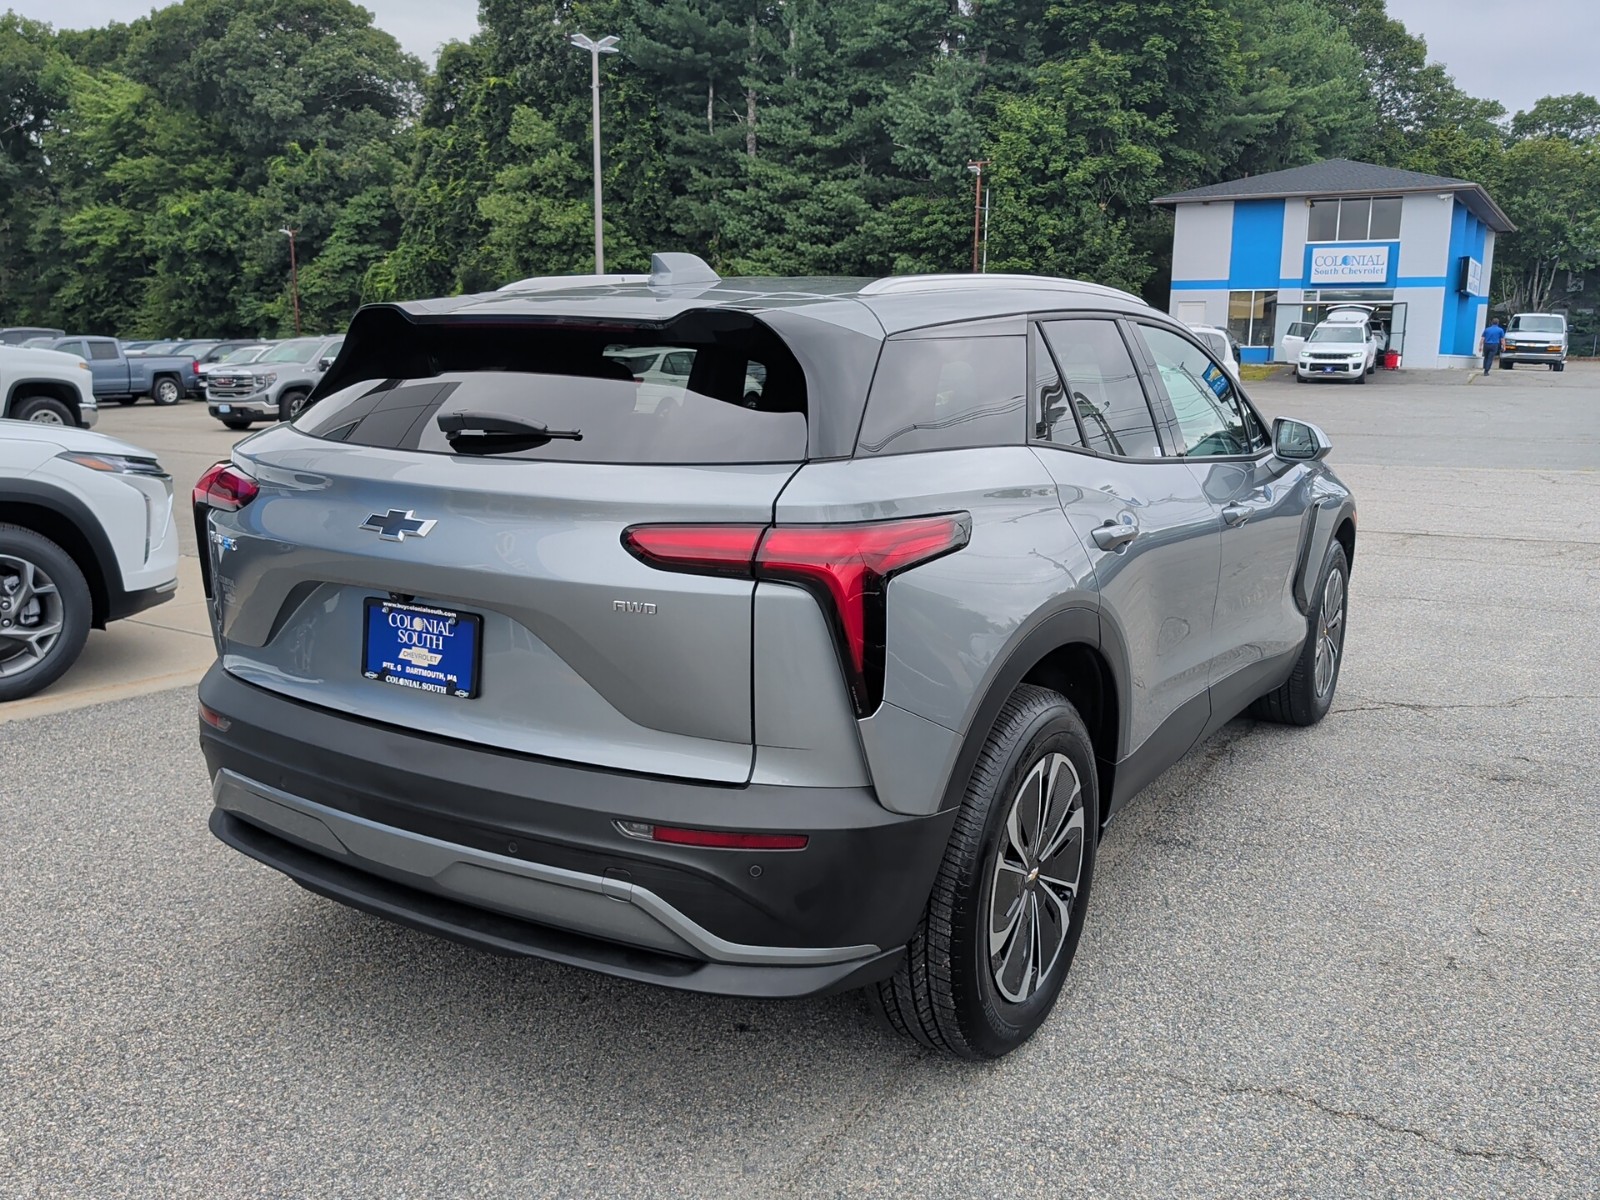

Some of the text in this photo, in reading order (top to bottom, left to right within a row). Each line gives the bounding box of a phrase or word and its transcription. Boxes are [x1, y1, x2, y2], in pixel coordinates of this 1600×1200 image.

[1315, 255, 1384, 267] COLONIAL
[1313, 266, 1384, 276] South Chevrolet
[388, 613, 454, 636] COLONIAL
[398, 629, 443, 649] SOUTH
[402, 650, 438, 663] CHEVROLET
[385, 675, 447, 694] COLONIAL SOUTH
